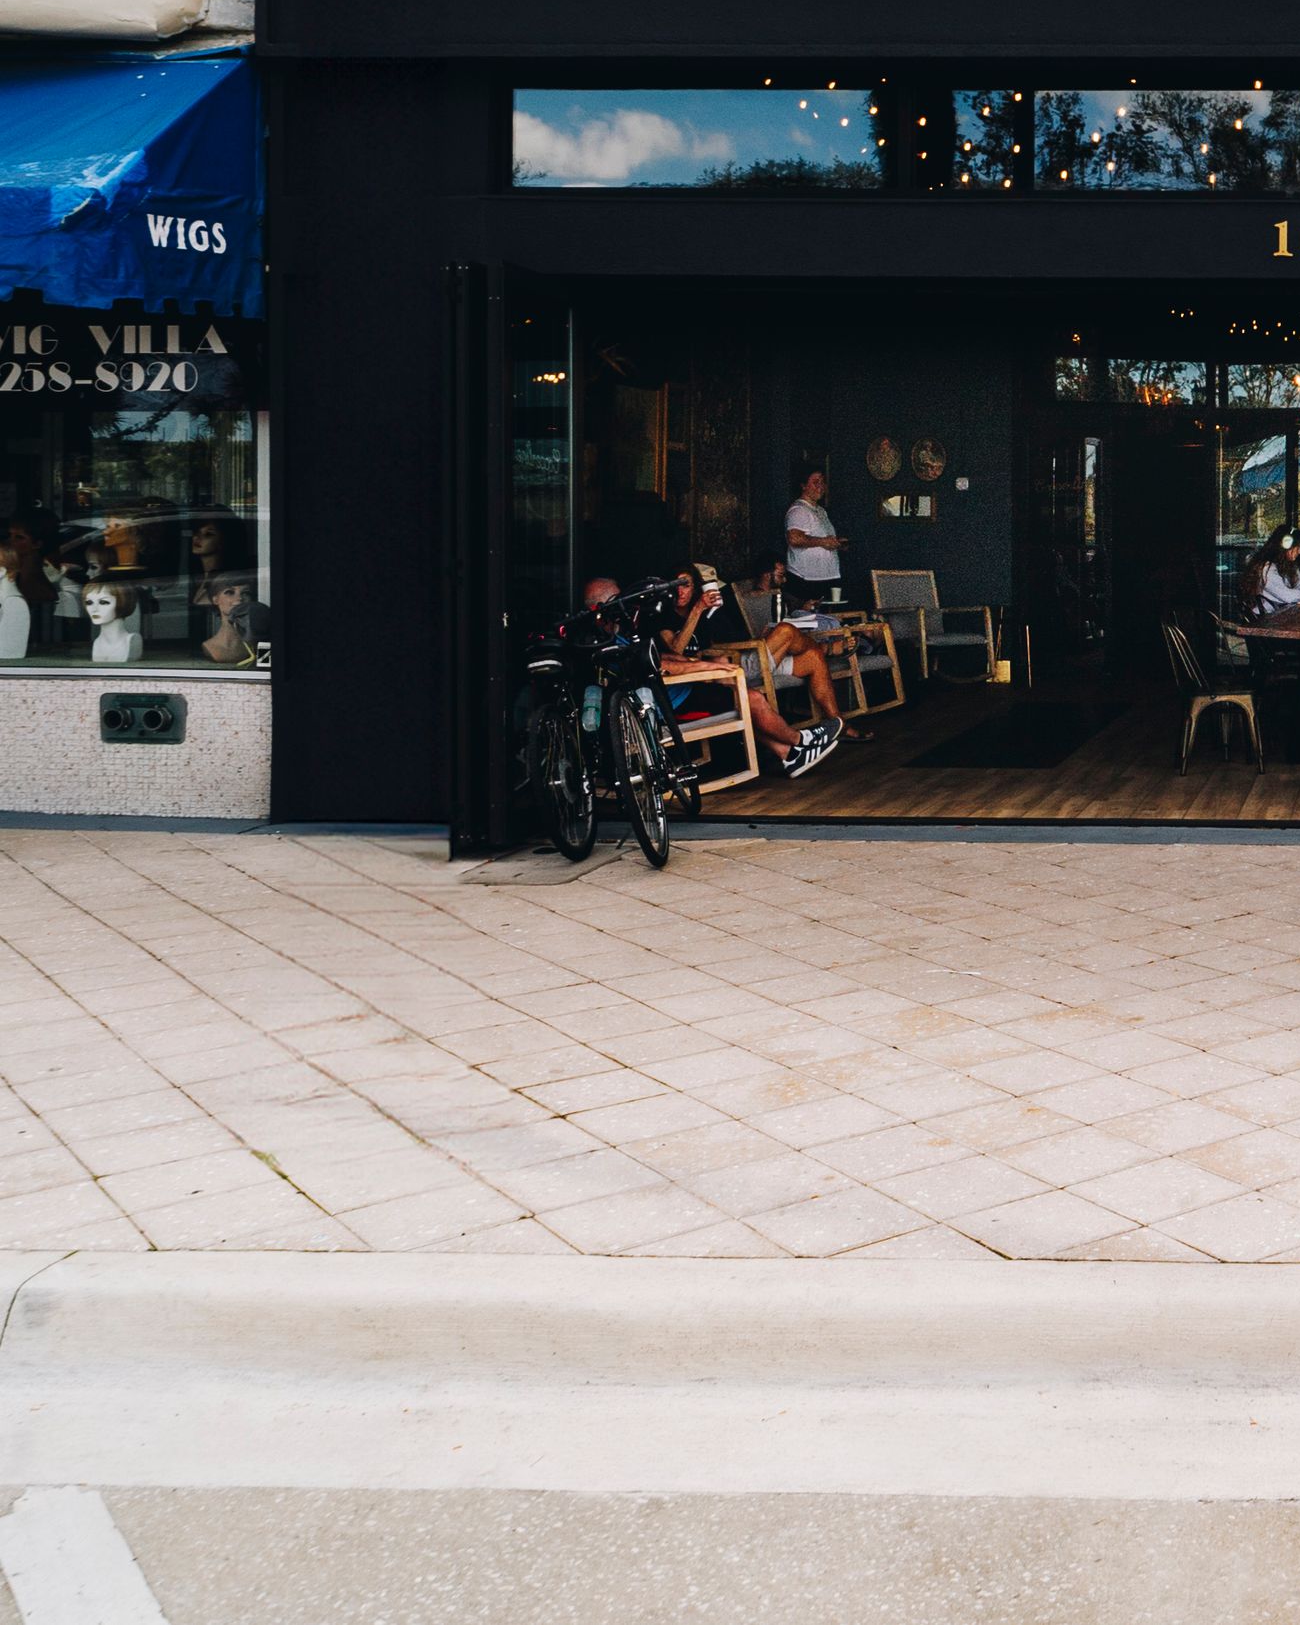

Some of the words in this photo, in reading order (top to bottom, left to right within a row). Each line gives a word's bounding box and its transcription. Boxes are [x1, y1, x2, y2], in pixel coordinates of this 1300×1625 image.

[146, 213, 227, 254] WIGS
[0, 325, 58, 355] IG
[88, 325, 228, 355] VILLA
[0, 361, 199, 392] 258-8920
